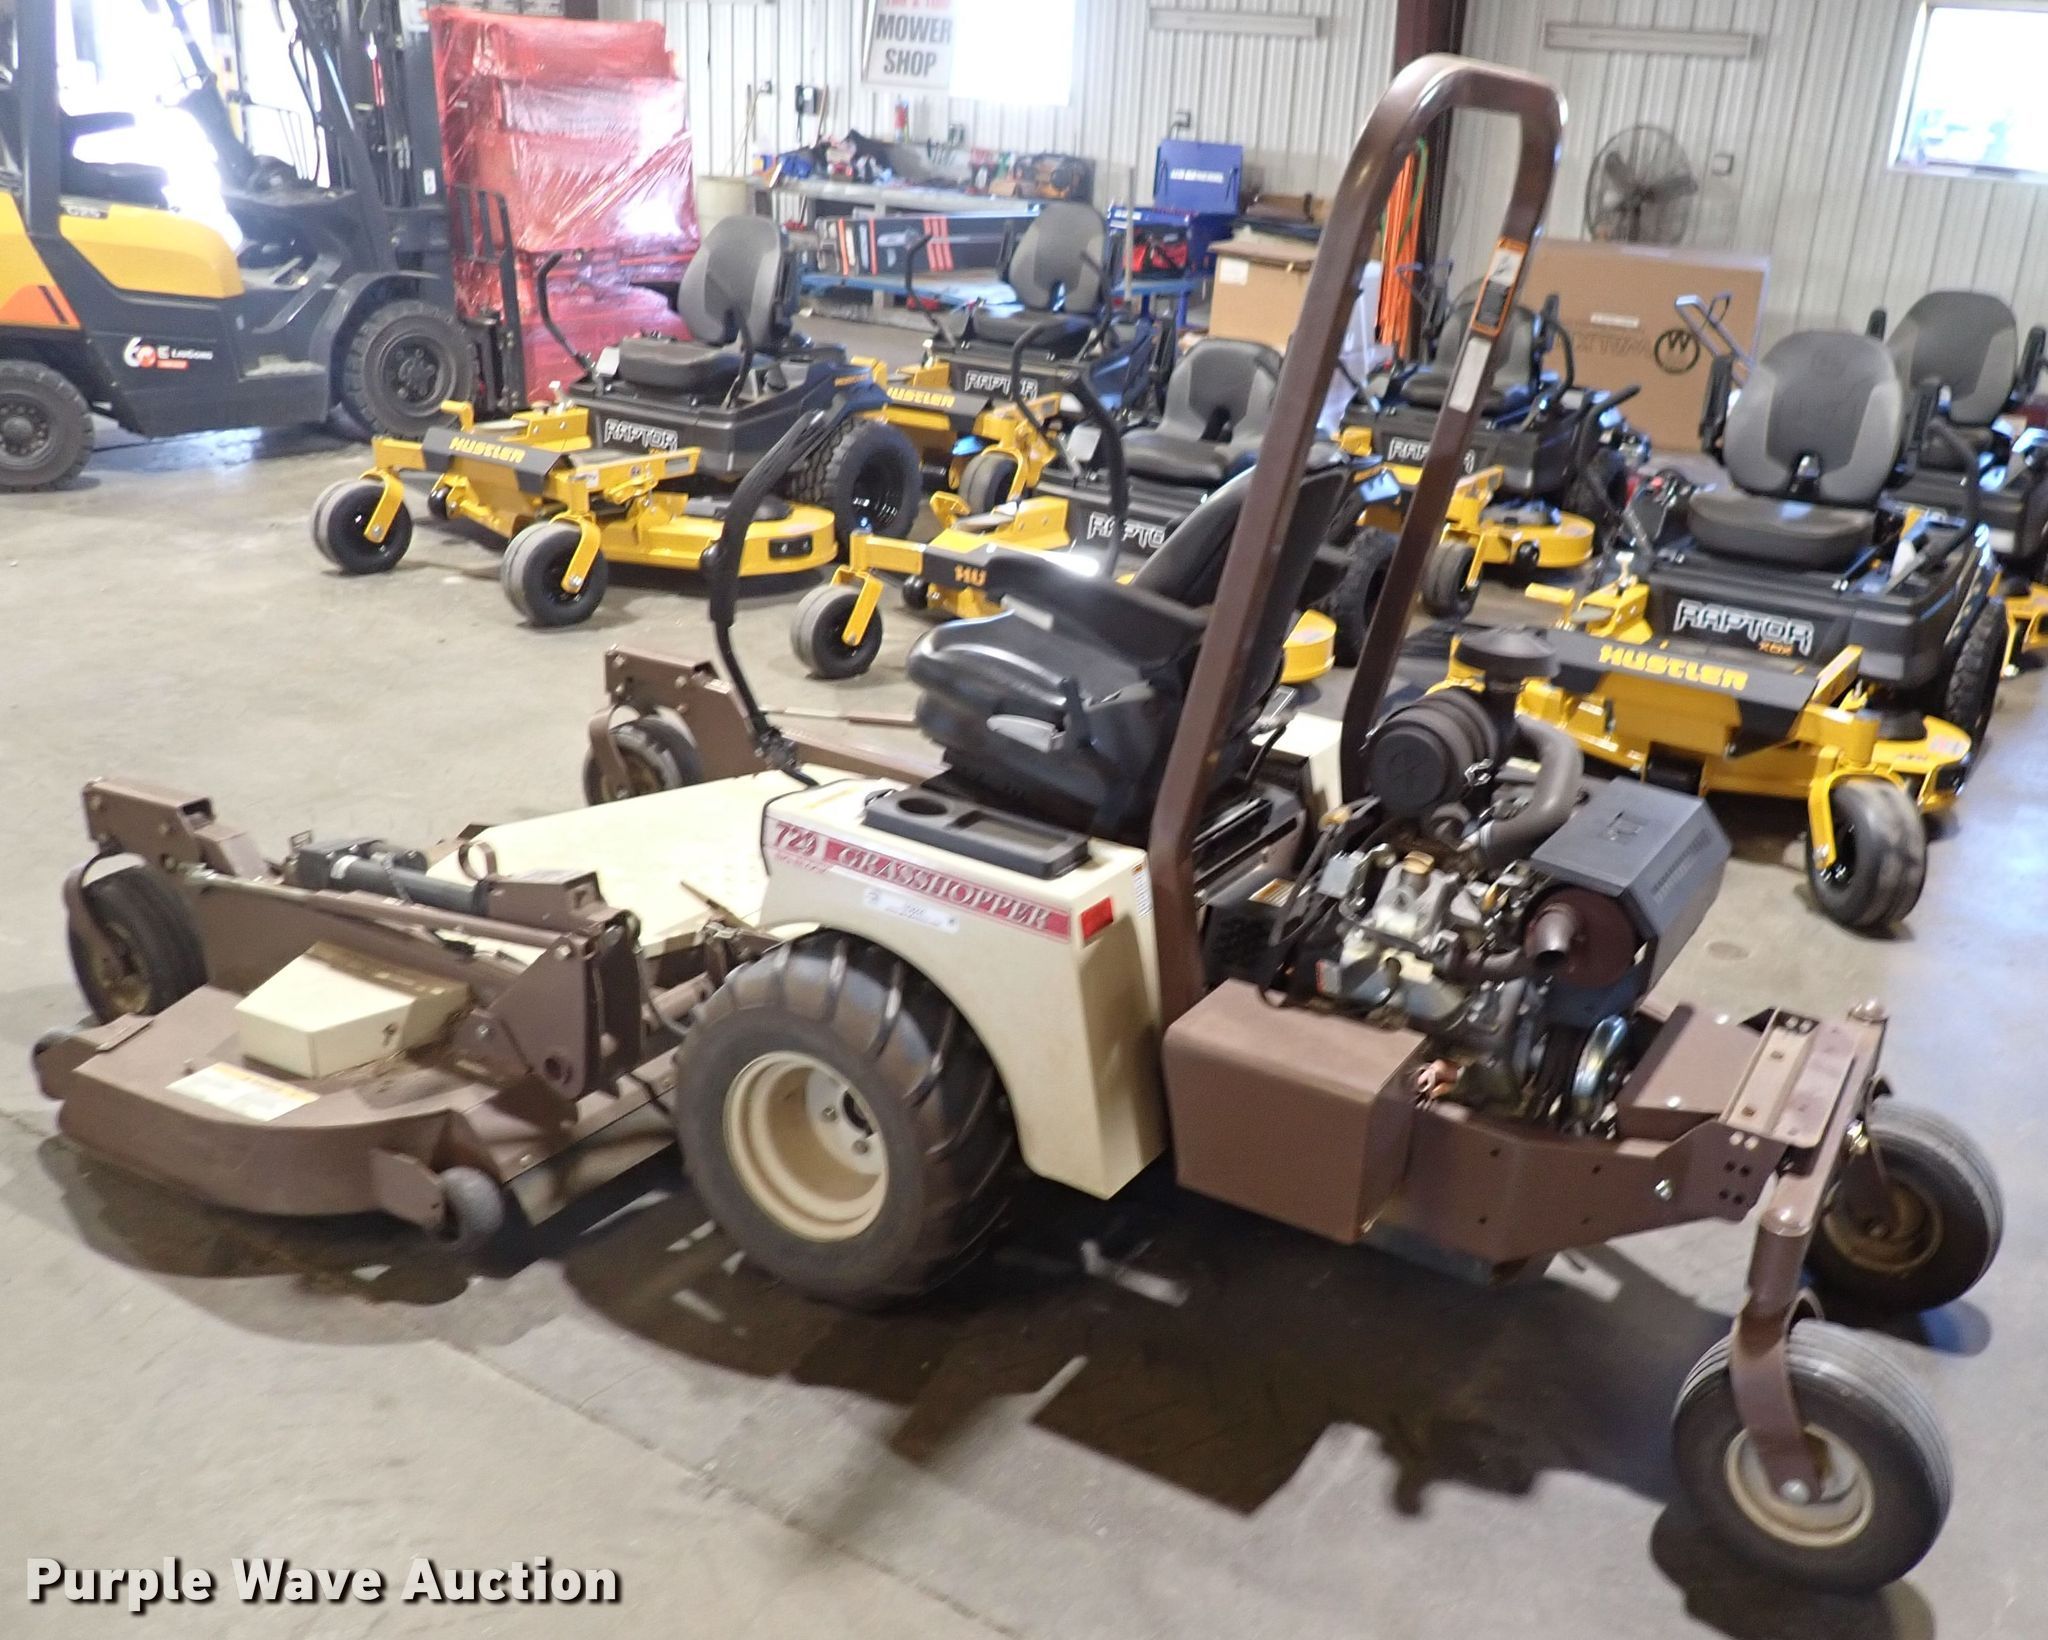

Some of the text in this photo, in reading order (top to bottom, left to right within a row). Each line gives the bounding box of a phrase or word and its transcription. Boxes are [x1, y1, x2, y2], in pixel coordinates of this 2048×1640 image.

[876, 14, 952, 43] MOWER
[884, 48, 937, 77] SHOP
[964, 370, 1038, 399] RAPTR
[449, 437, 526, 463] HUSTLER
[604, 418, 679, 451] RAPTOR
[1673, 599, 1814, 656] RAPTOR
[1599, 644, 1748, 691] HUSTLER
[776, 820, 817, 857] 729
[838, 846, 1050, 931] GRASSHOPPER
